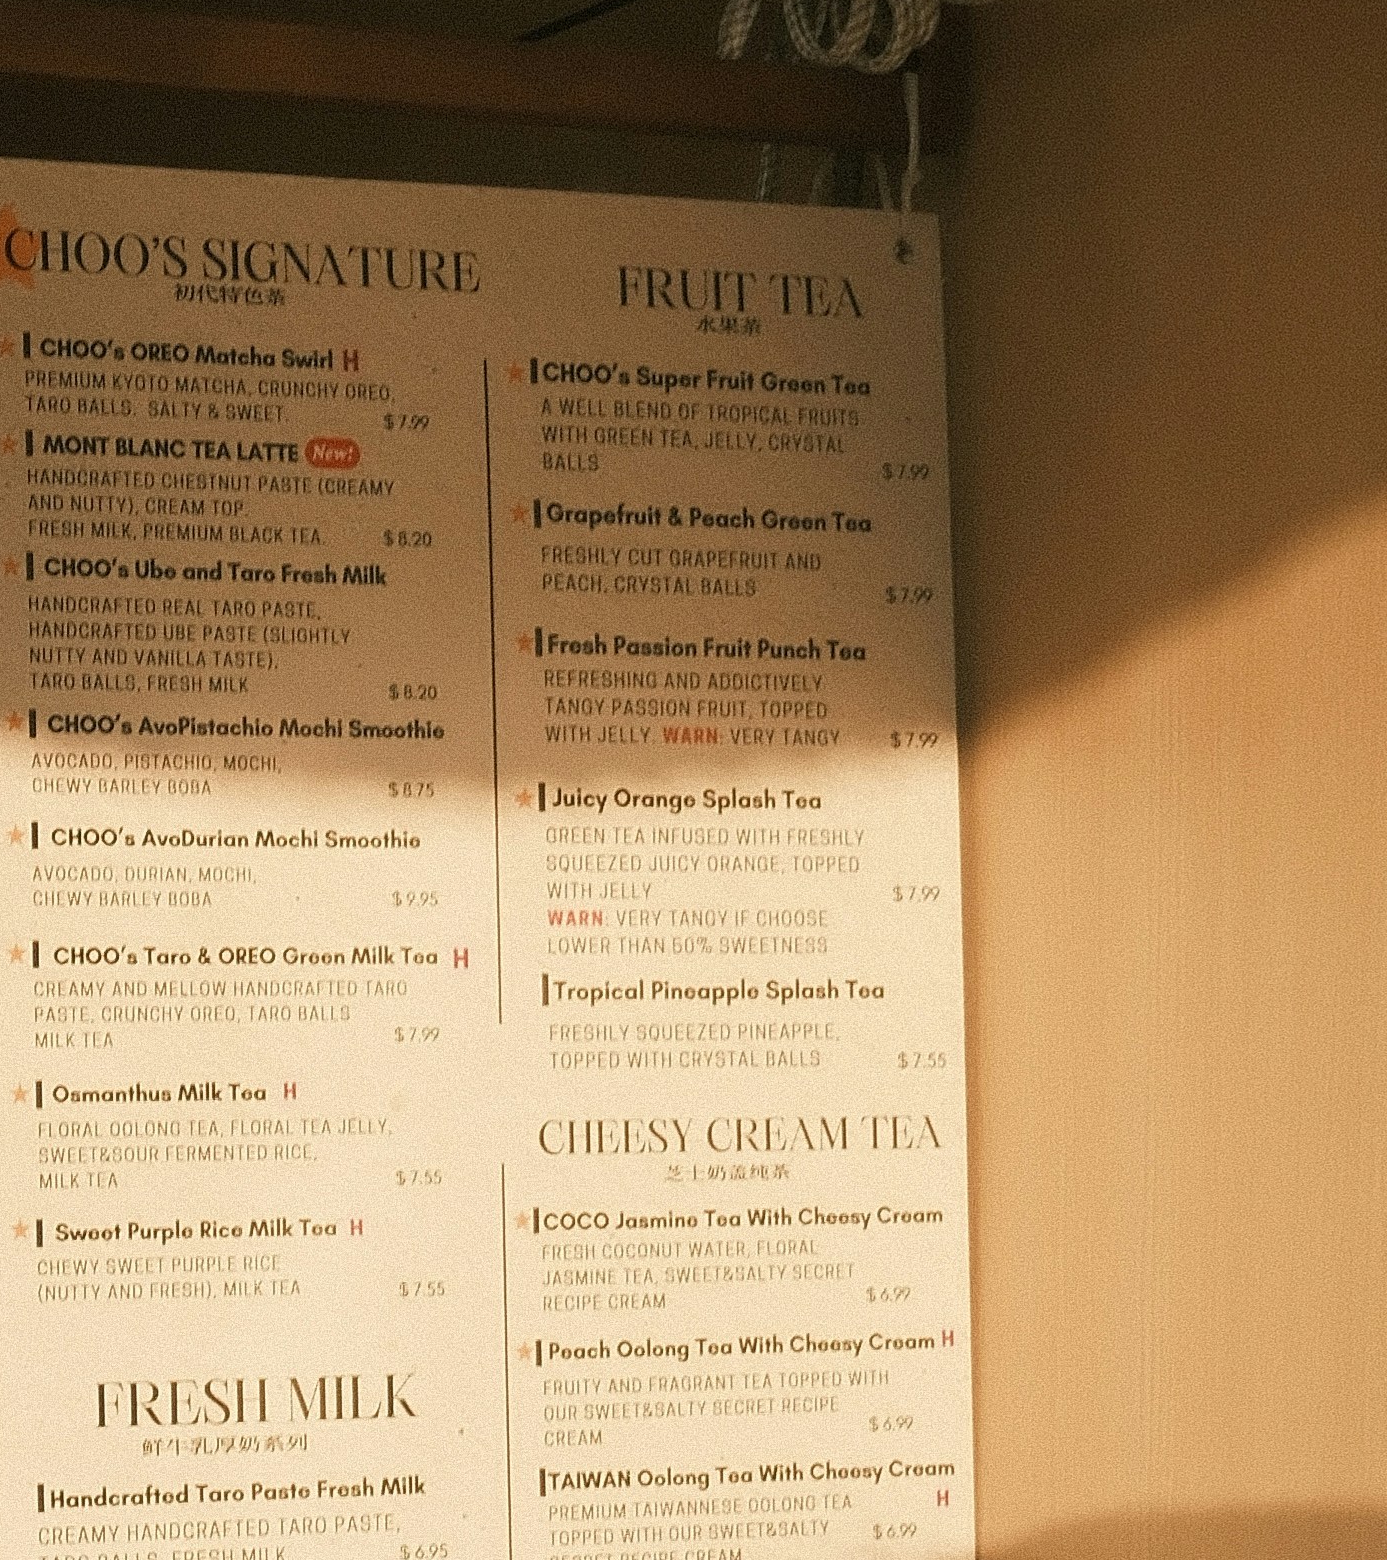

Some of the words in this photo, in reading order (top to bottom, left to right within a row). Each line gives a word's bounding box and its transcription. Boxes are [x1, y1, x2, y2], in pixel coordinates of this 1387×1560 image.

[5, 229, 187, 278] CHOO'S
[197, 239, 479, 294] SIGNATURE
[619, 266, 755, 312] FRUIT
[770, 274, 863, 318] TEA
[636, 365, 701, 393] Super
[706, 368, 754, 390] Fruit
[760, 371, 826, 393] Green
[831, 374, 871, 396] Tea
[43, 435, 109, 455] MONT
[115, 437, 185, 458] BLANC
[192, 440, 231, 460] TEA
[237, 442, 298, 463] LATTE
[311, 442, 354, 463] New!
[539, 1119, 686, 1155] CHEESY
[707, 1117, 847, 1152] CREAM
[862, 1116, 941, 1150] TEA
[98, 1379, 266, 1428] FRESH
[291, 1374, 415, 1420] MILK
